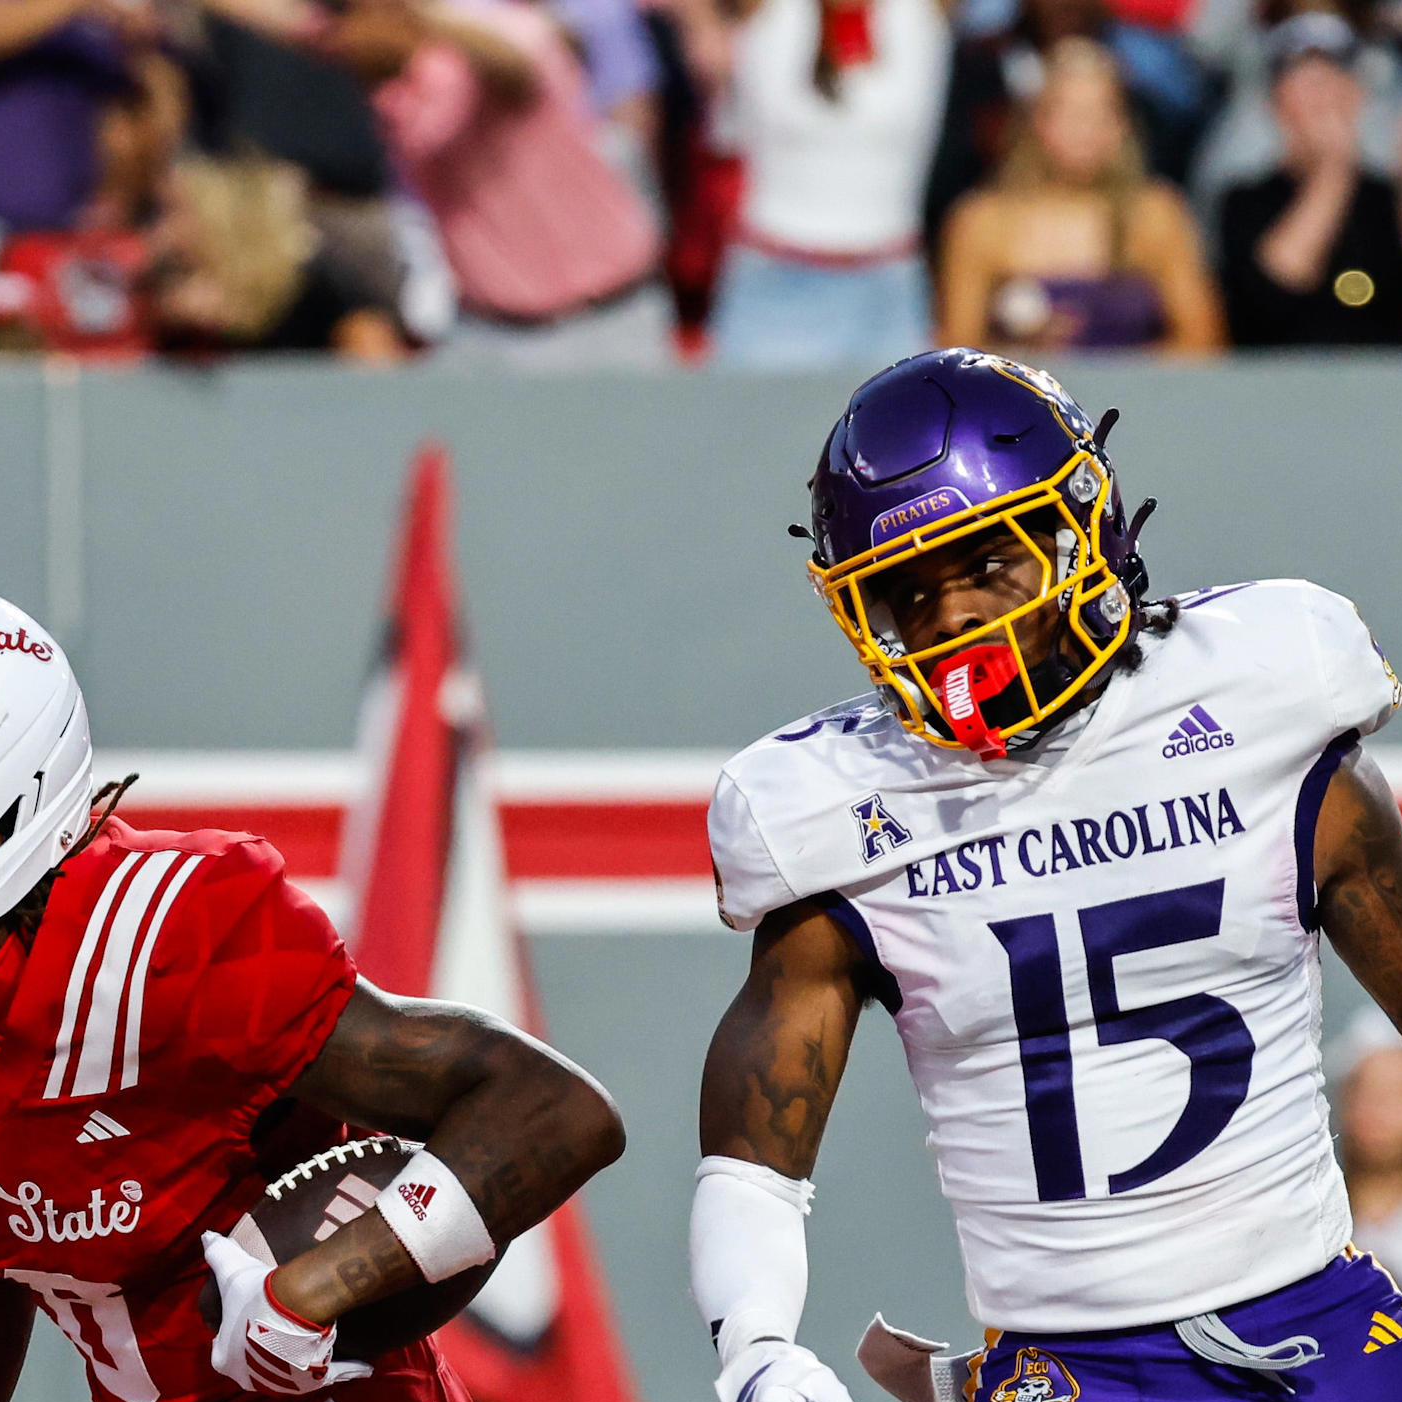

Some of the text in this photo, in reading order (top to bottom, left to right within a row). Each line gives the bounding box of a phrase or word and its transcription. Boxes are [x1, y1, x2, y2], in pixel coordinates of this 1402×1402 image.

[879, 492, 951, 533] PIRATES
[1162, 732, 1235, 759] adidas
[905, 787, 1247, 899] EAST CAROLINA
[987, 877, 1257, 1203] 15
[398, 1184, 428, 1221] adidas
[1024, 1361, 1050, 1375] ECU
